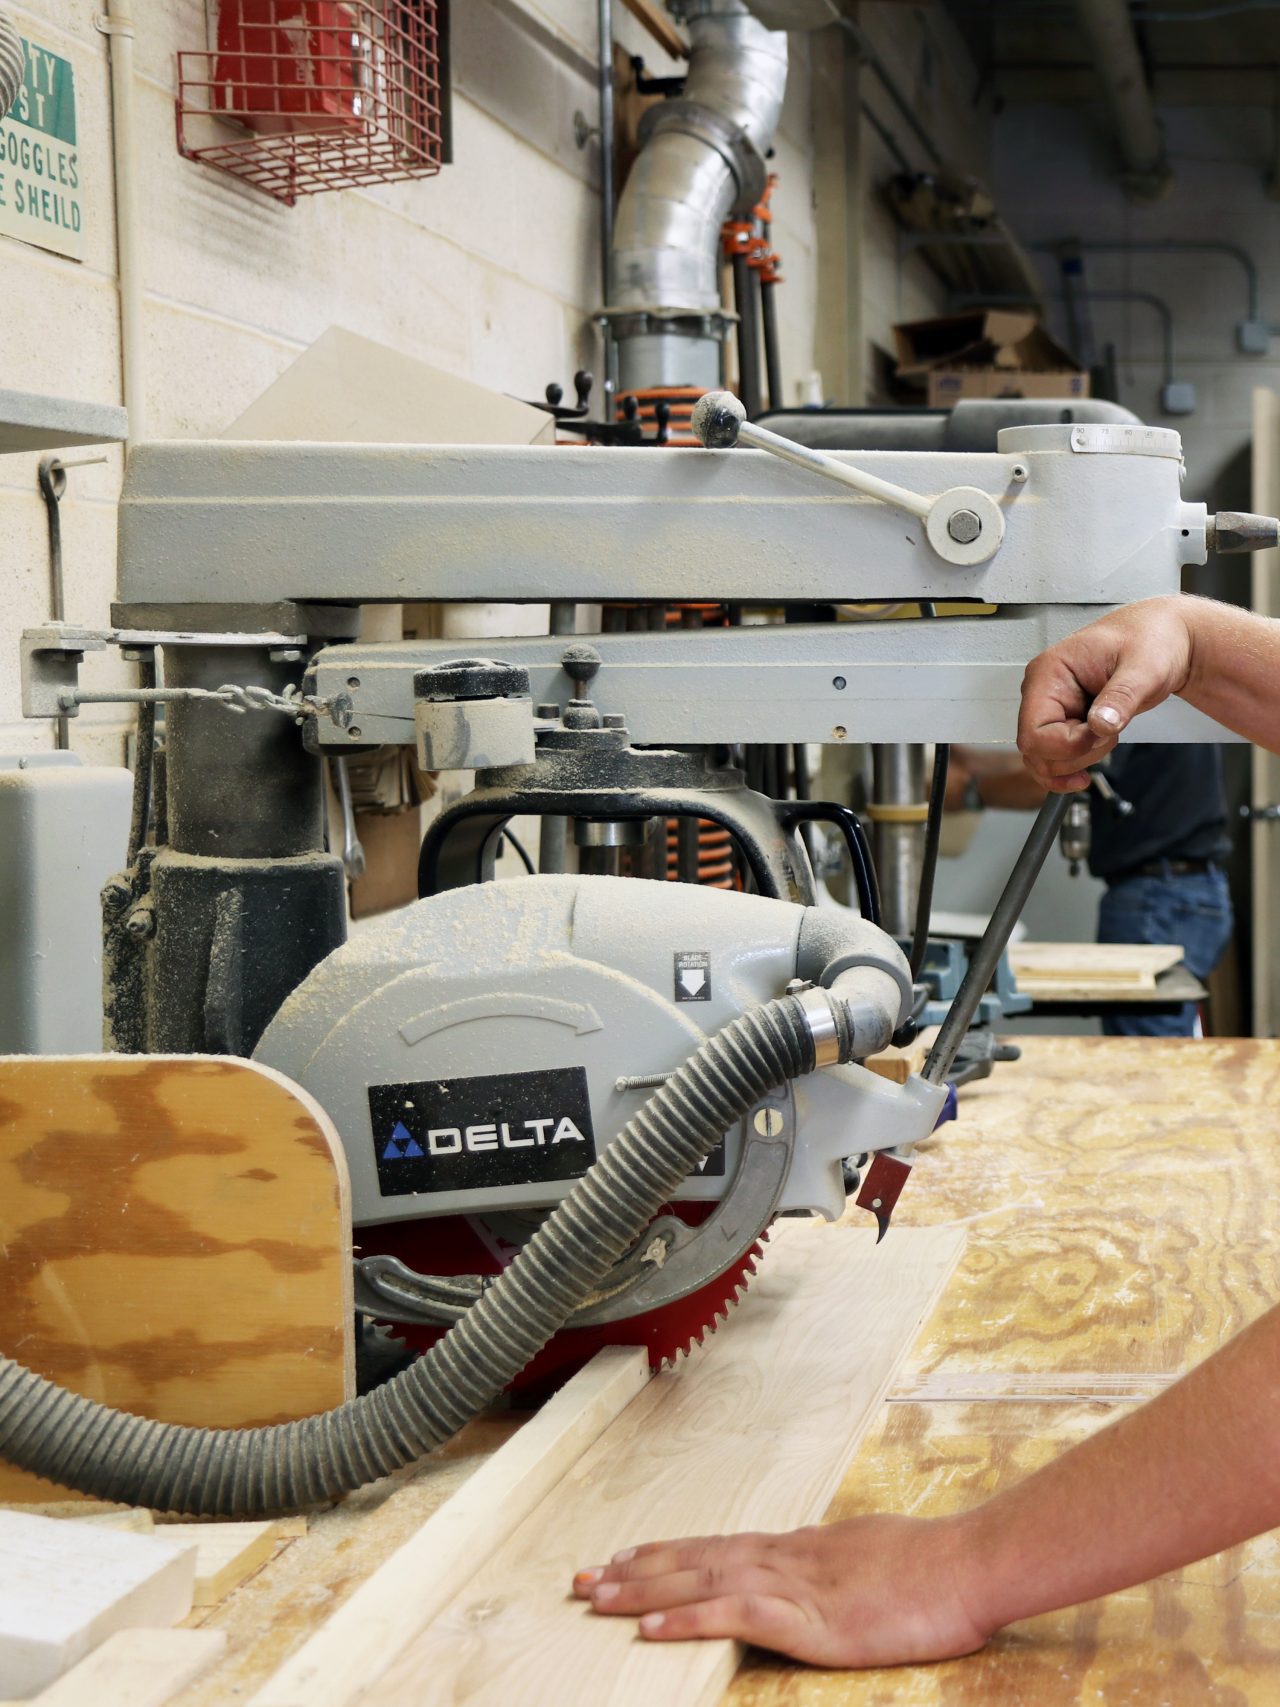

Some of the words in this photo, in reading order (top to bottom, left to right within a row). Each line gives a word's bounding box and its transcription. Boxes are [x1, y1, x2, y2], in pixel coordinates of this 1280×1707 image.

[29, 48, 55, 95] TY
[18, 84, 45, 127] ST
[0, 127, 78, 189] GOGGLES
[15, 178, 80, 233] SHEILD
[428, 1116, 585, 1155] DELTA
